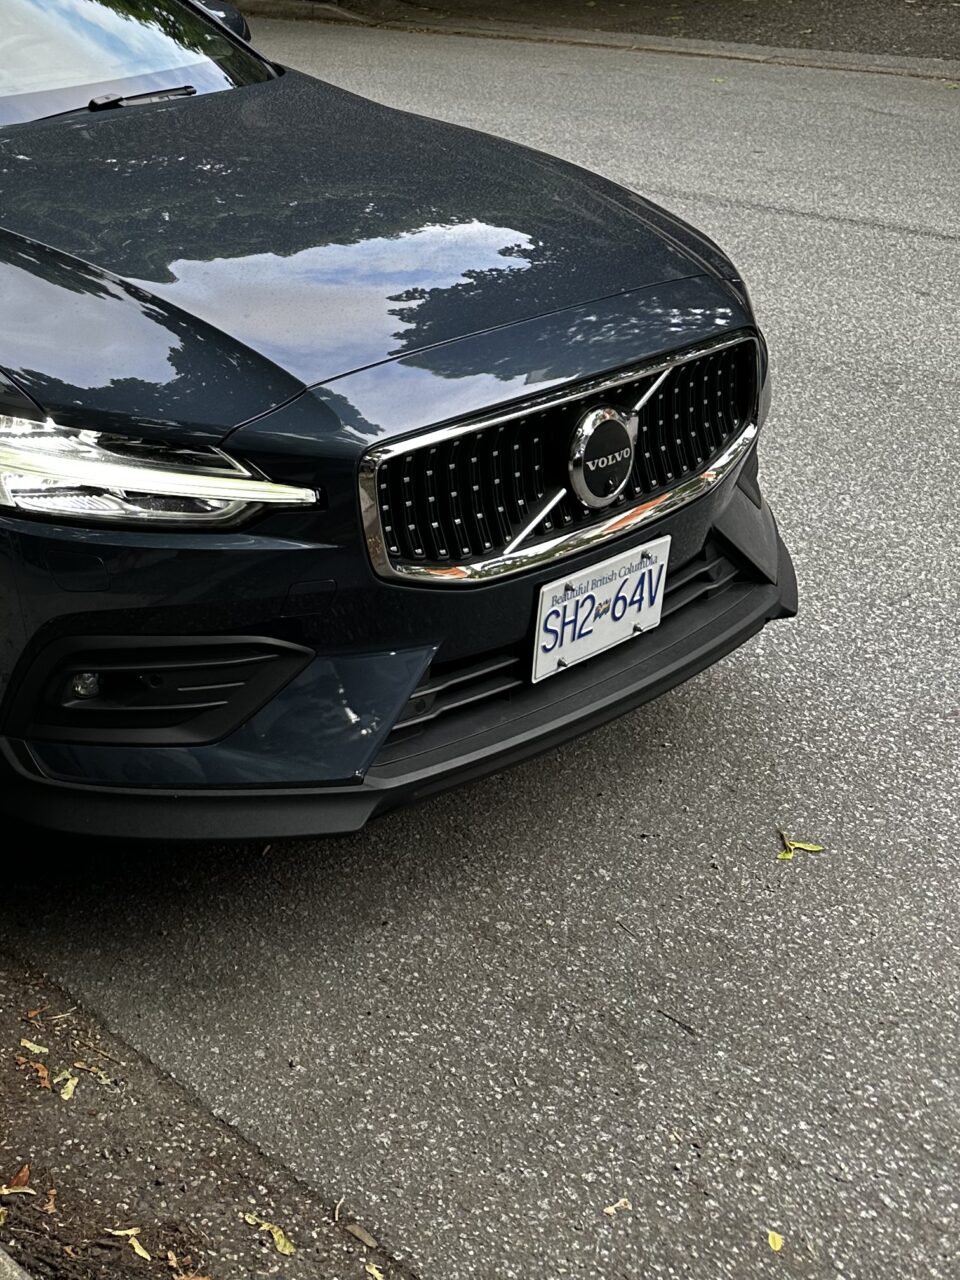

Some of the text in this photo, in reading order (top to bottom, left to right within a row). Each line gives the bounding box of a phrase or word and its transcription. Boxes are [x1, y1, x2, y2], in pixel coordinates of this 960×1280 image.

[586, 447, 631, 471] VOLVO
[551, 555, 658, 607] Beautiful British Columbia
[541, 563, 665, 654] SH2 64V
